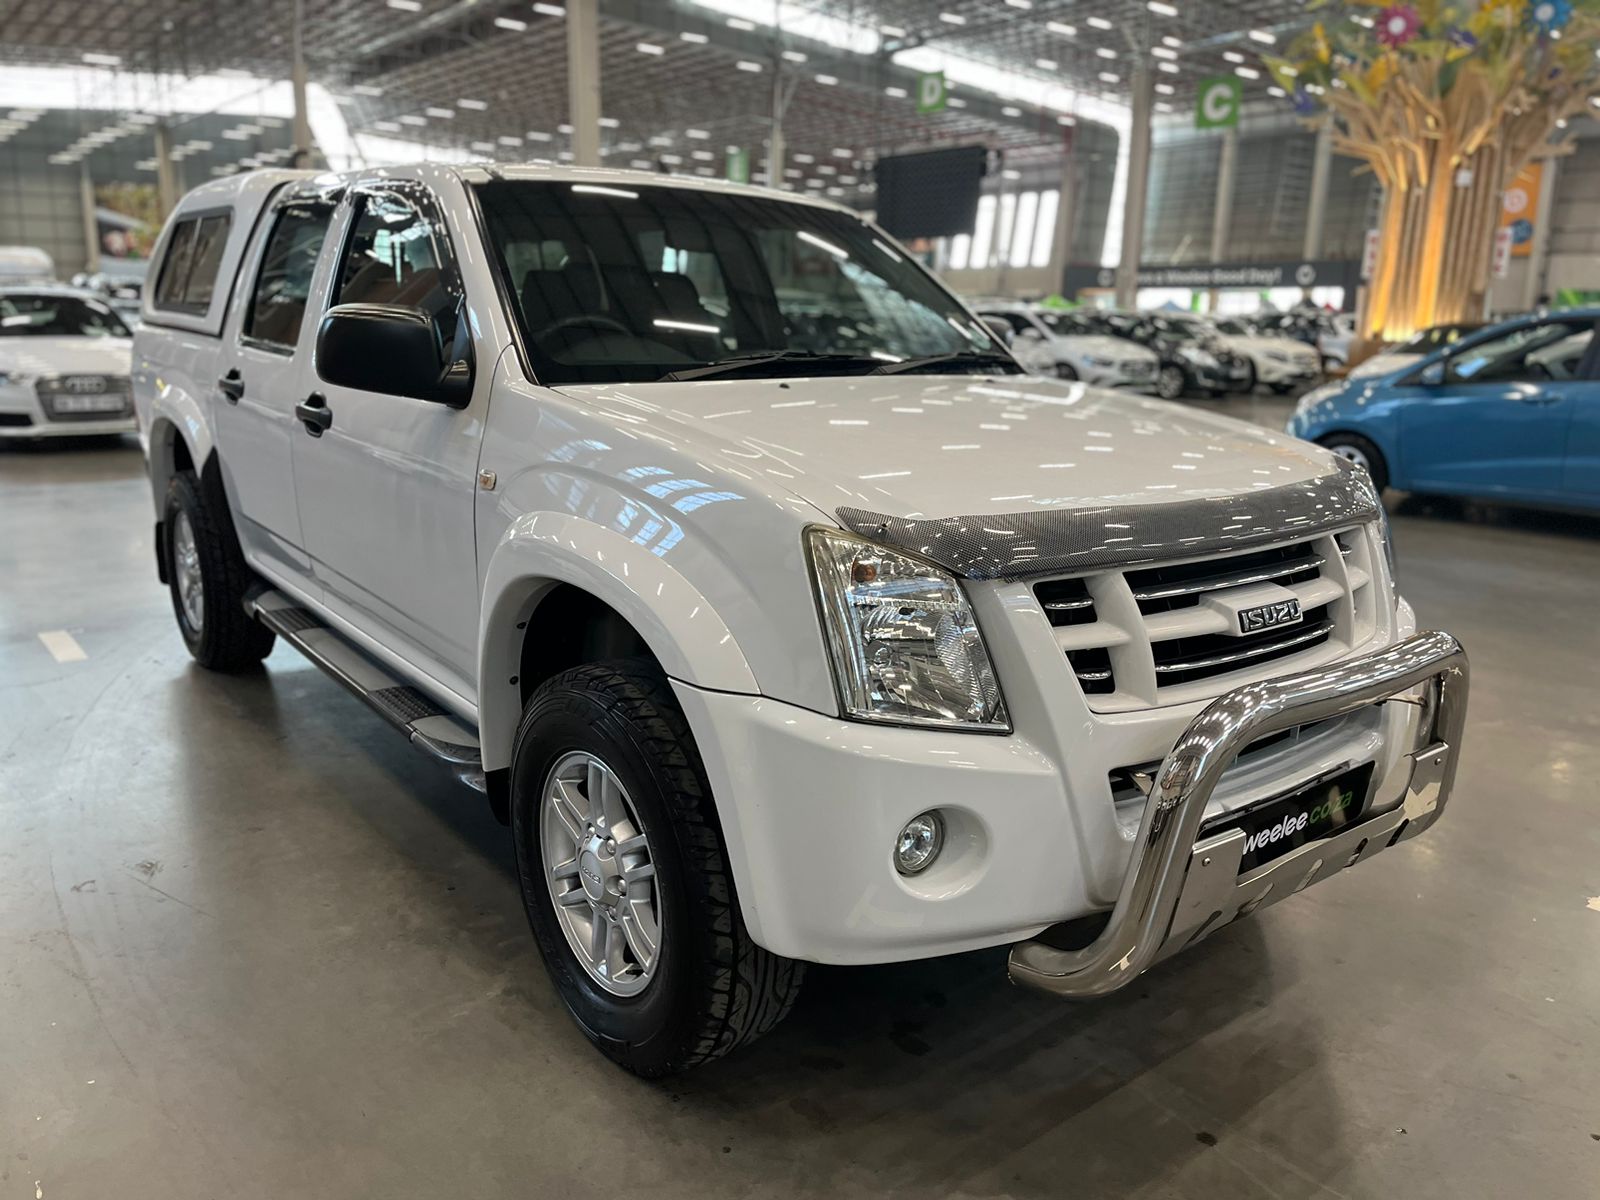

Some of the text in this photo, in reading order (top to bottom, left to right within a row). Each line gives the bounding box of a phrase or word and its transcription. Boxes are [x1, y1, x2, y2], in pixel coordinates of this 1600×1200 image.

[921, 77, 942, 105] D
[1203, 83, 1233, 121] C
[1241, 600, 1301, 632] ISUZU
